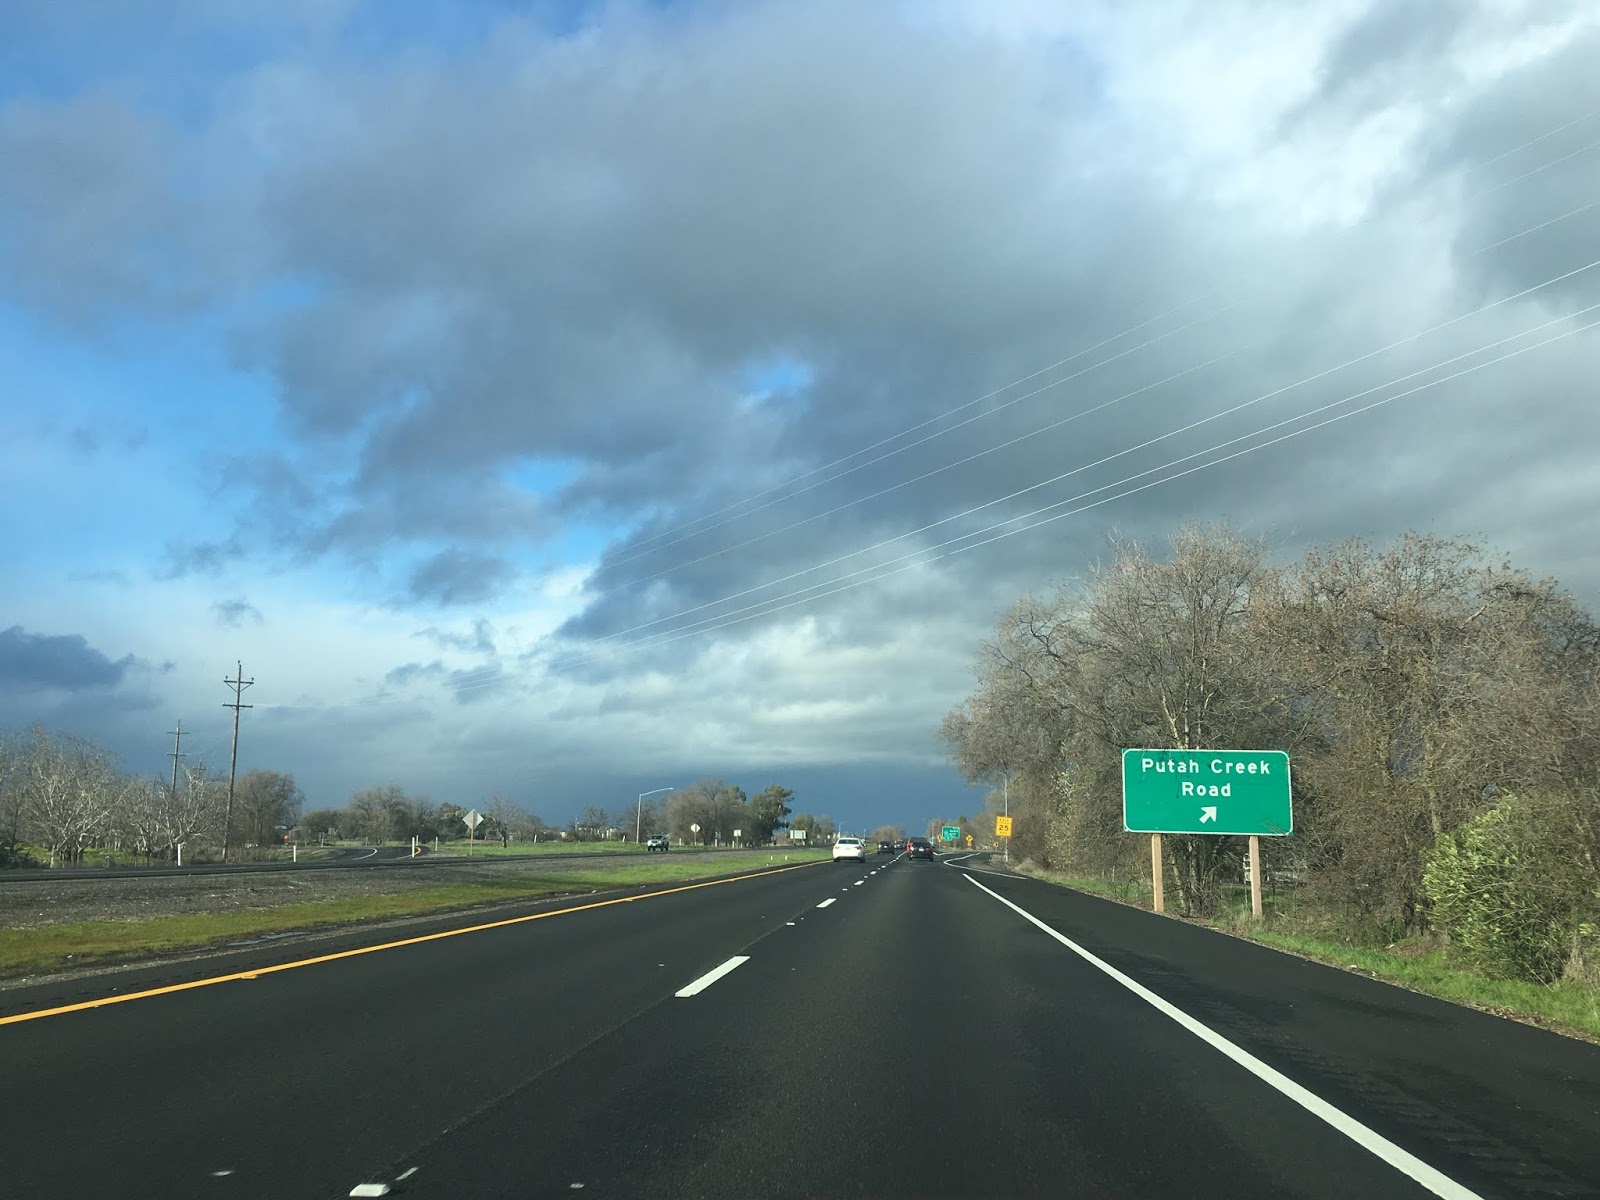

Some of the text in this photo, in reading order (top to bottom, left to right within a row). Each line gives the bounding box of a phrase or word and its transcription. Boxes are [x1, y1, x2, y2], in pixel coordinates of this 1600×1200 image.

[1142, 758, 1270, 774] Putah Creek
[1181, 781, 1231, 797] Road
[999, 824, 1009, 832] 25
